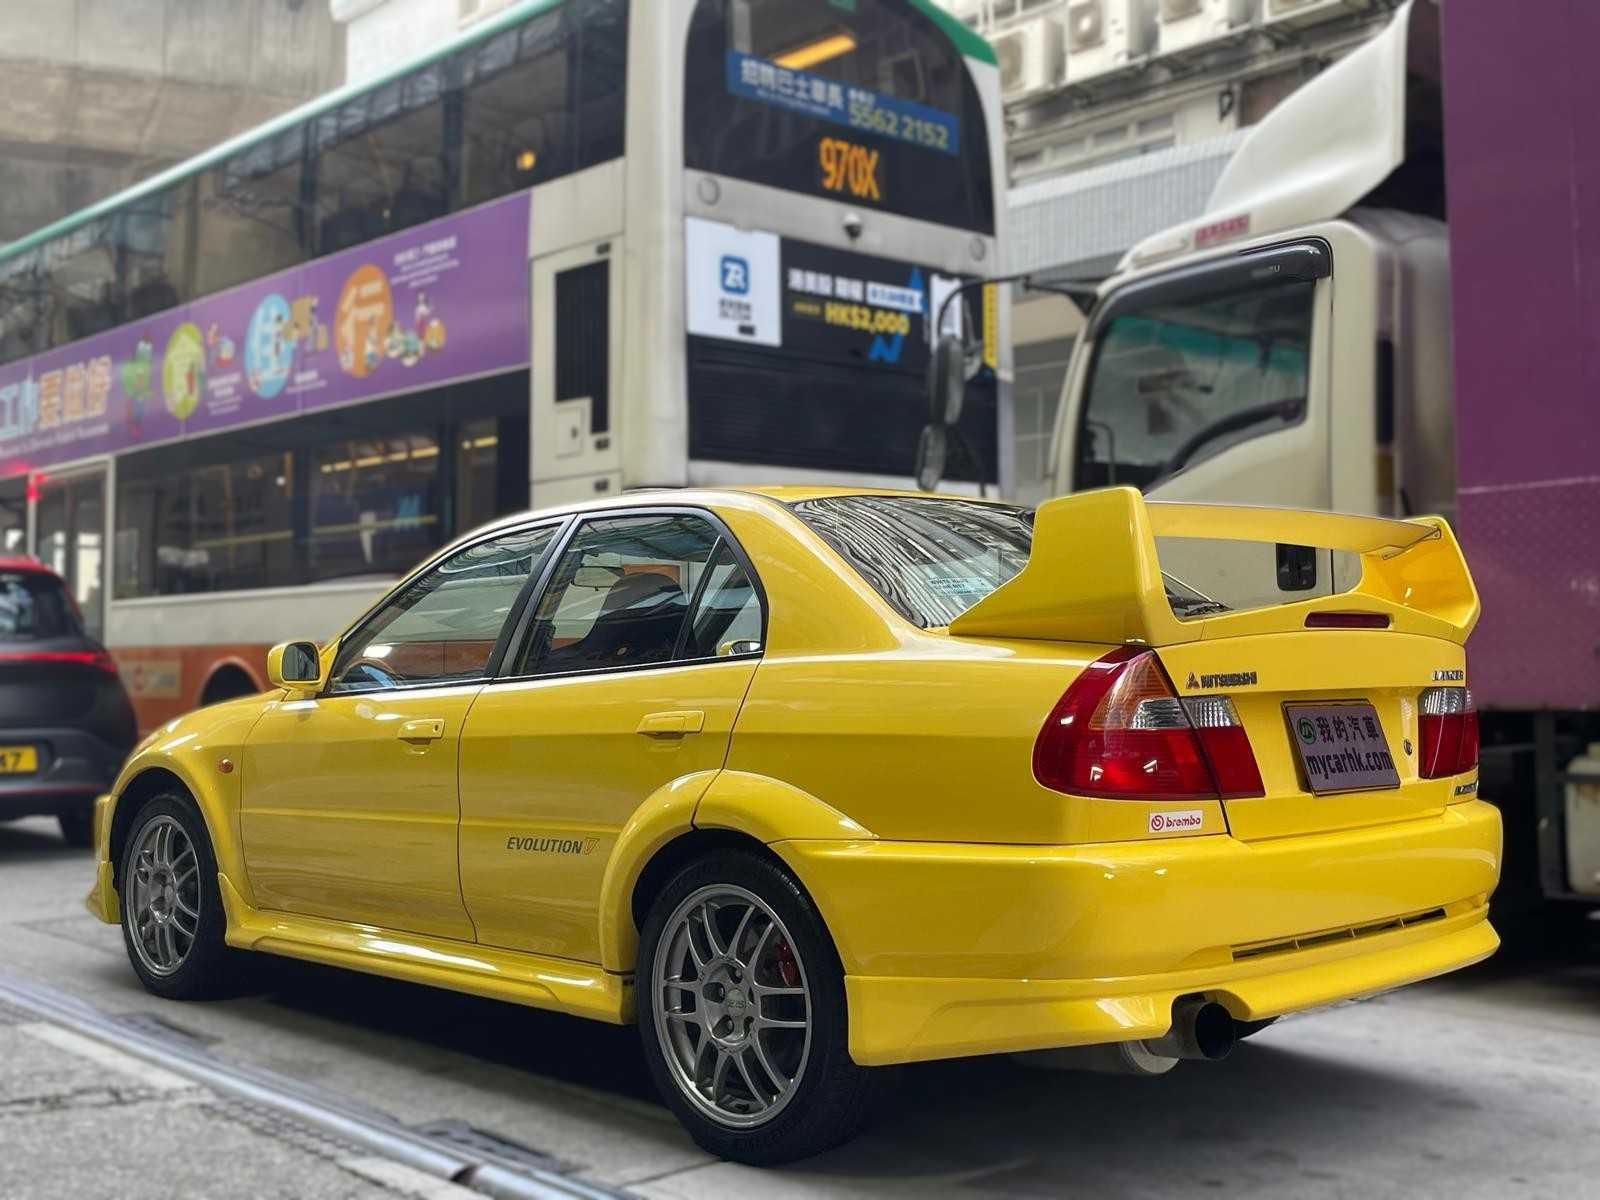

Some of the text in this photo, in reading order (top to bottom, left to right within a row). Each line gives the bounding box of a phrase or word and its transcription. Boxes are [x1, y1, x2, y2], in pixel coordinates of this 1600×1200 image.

[849, 103, 948, 150] 5562 2152
[818, 137, 881, 199] 970X
[1315, 714, 1380, 743] 我的汽車
[1305, 747, 1395, 780] mycarhk.com
[1166, 814, 1201, 828] brembo
[506, 836, 583, 854] EVOLUTION
